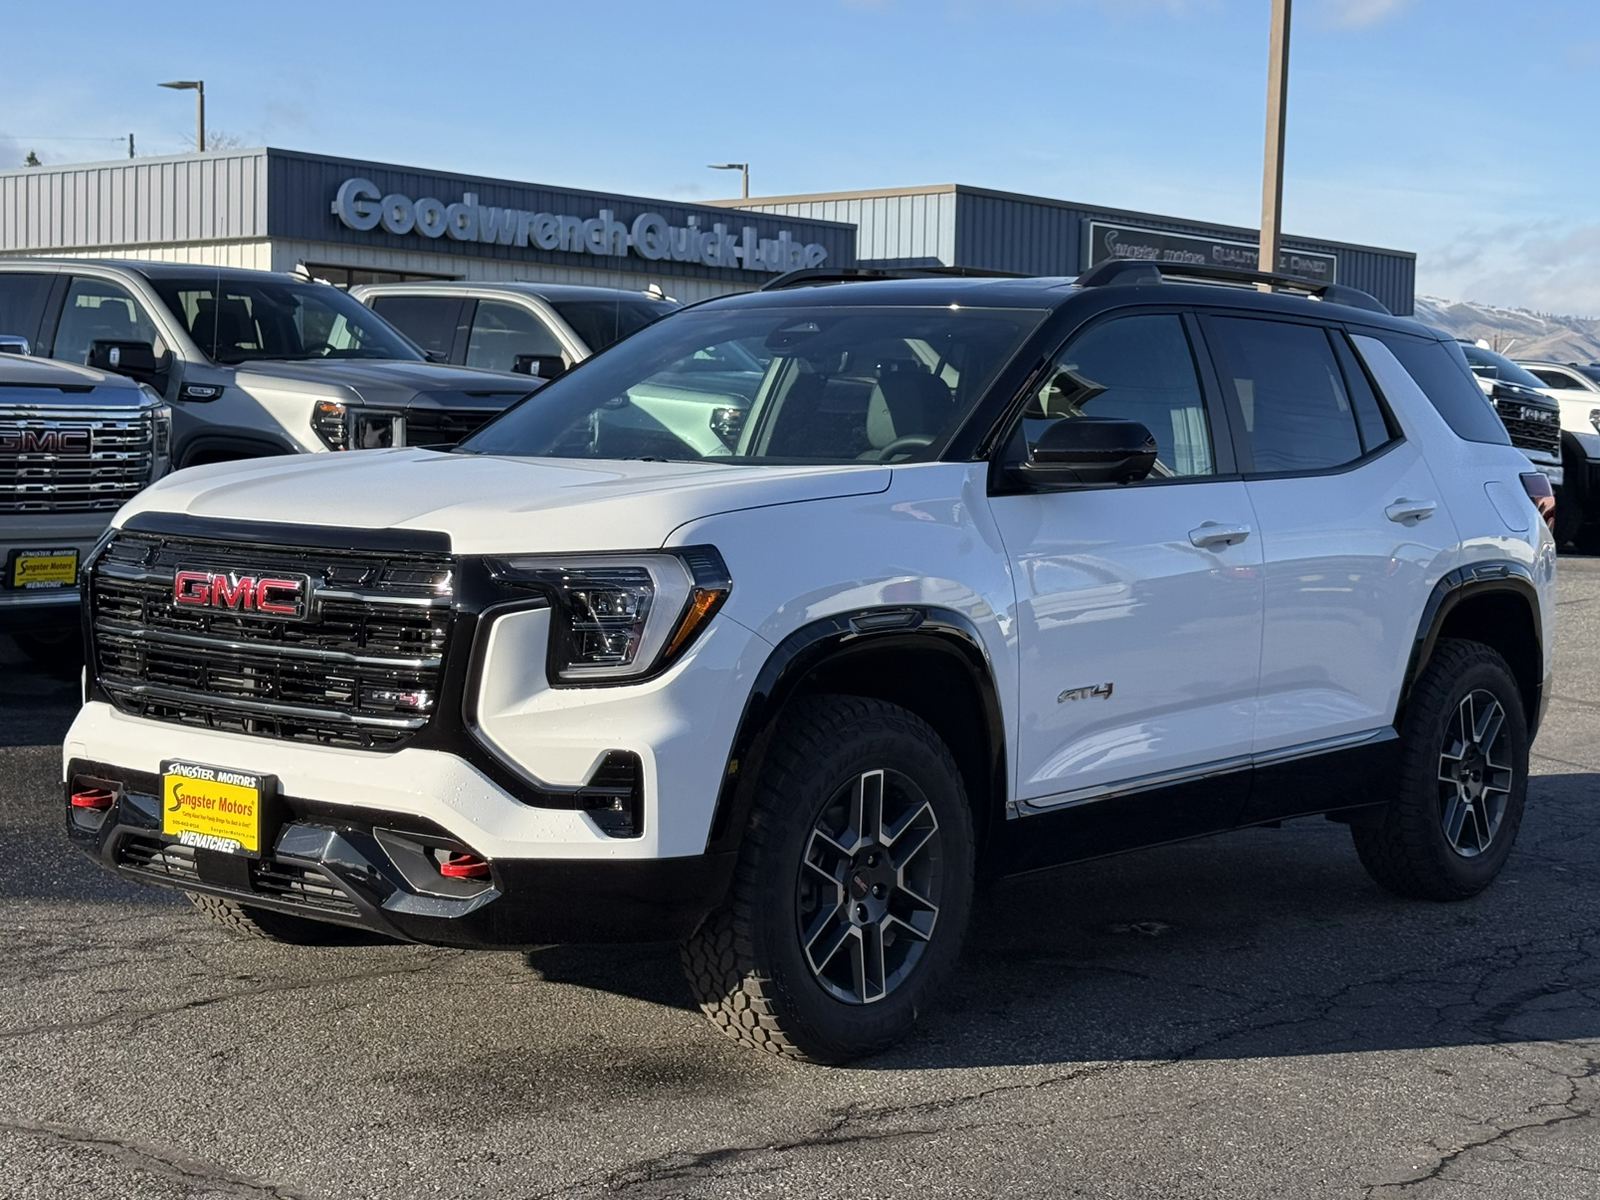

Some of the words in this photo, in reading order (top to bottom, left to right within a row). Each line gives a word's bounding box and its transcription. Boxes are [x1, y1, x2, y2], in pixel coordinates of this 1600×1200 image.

[335, 177, 628, 257] Goodwrench
[17, 560, 49, 576] Sangster
[50, 562, 72, 570] Motors
[174, 570, 302, 614] GMC
[163, 763, 216, 781] SANGSTER
[217, 772, 257, 788] MOTORS
[168, 783, 216, 812] Sangster
[218, 797, 253, 816] Motors
[179, 830, 236, 854] WENATCHEE
